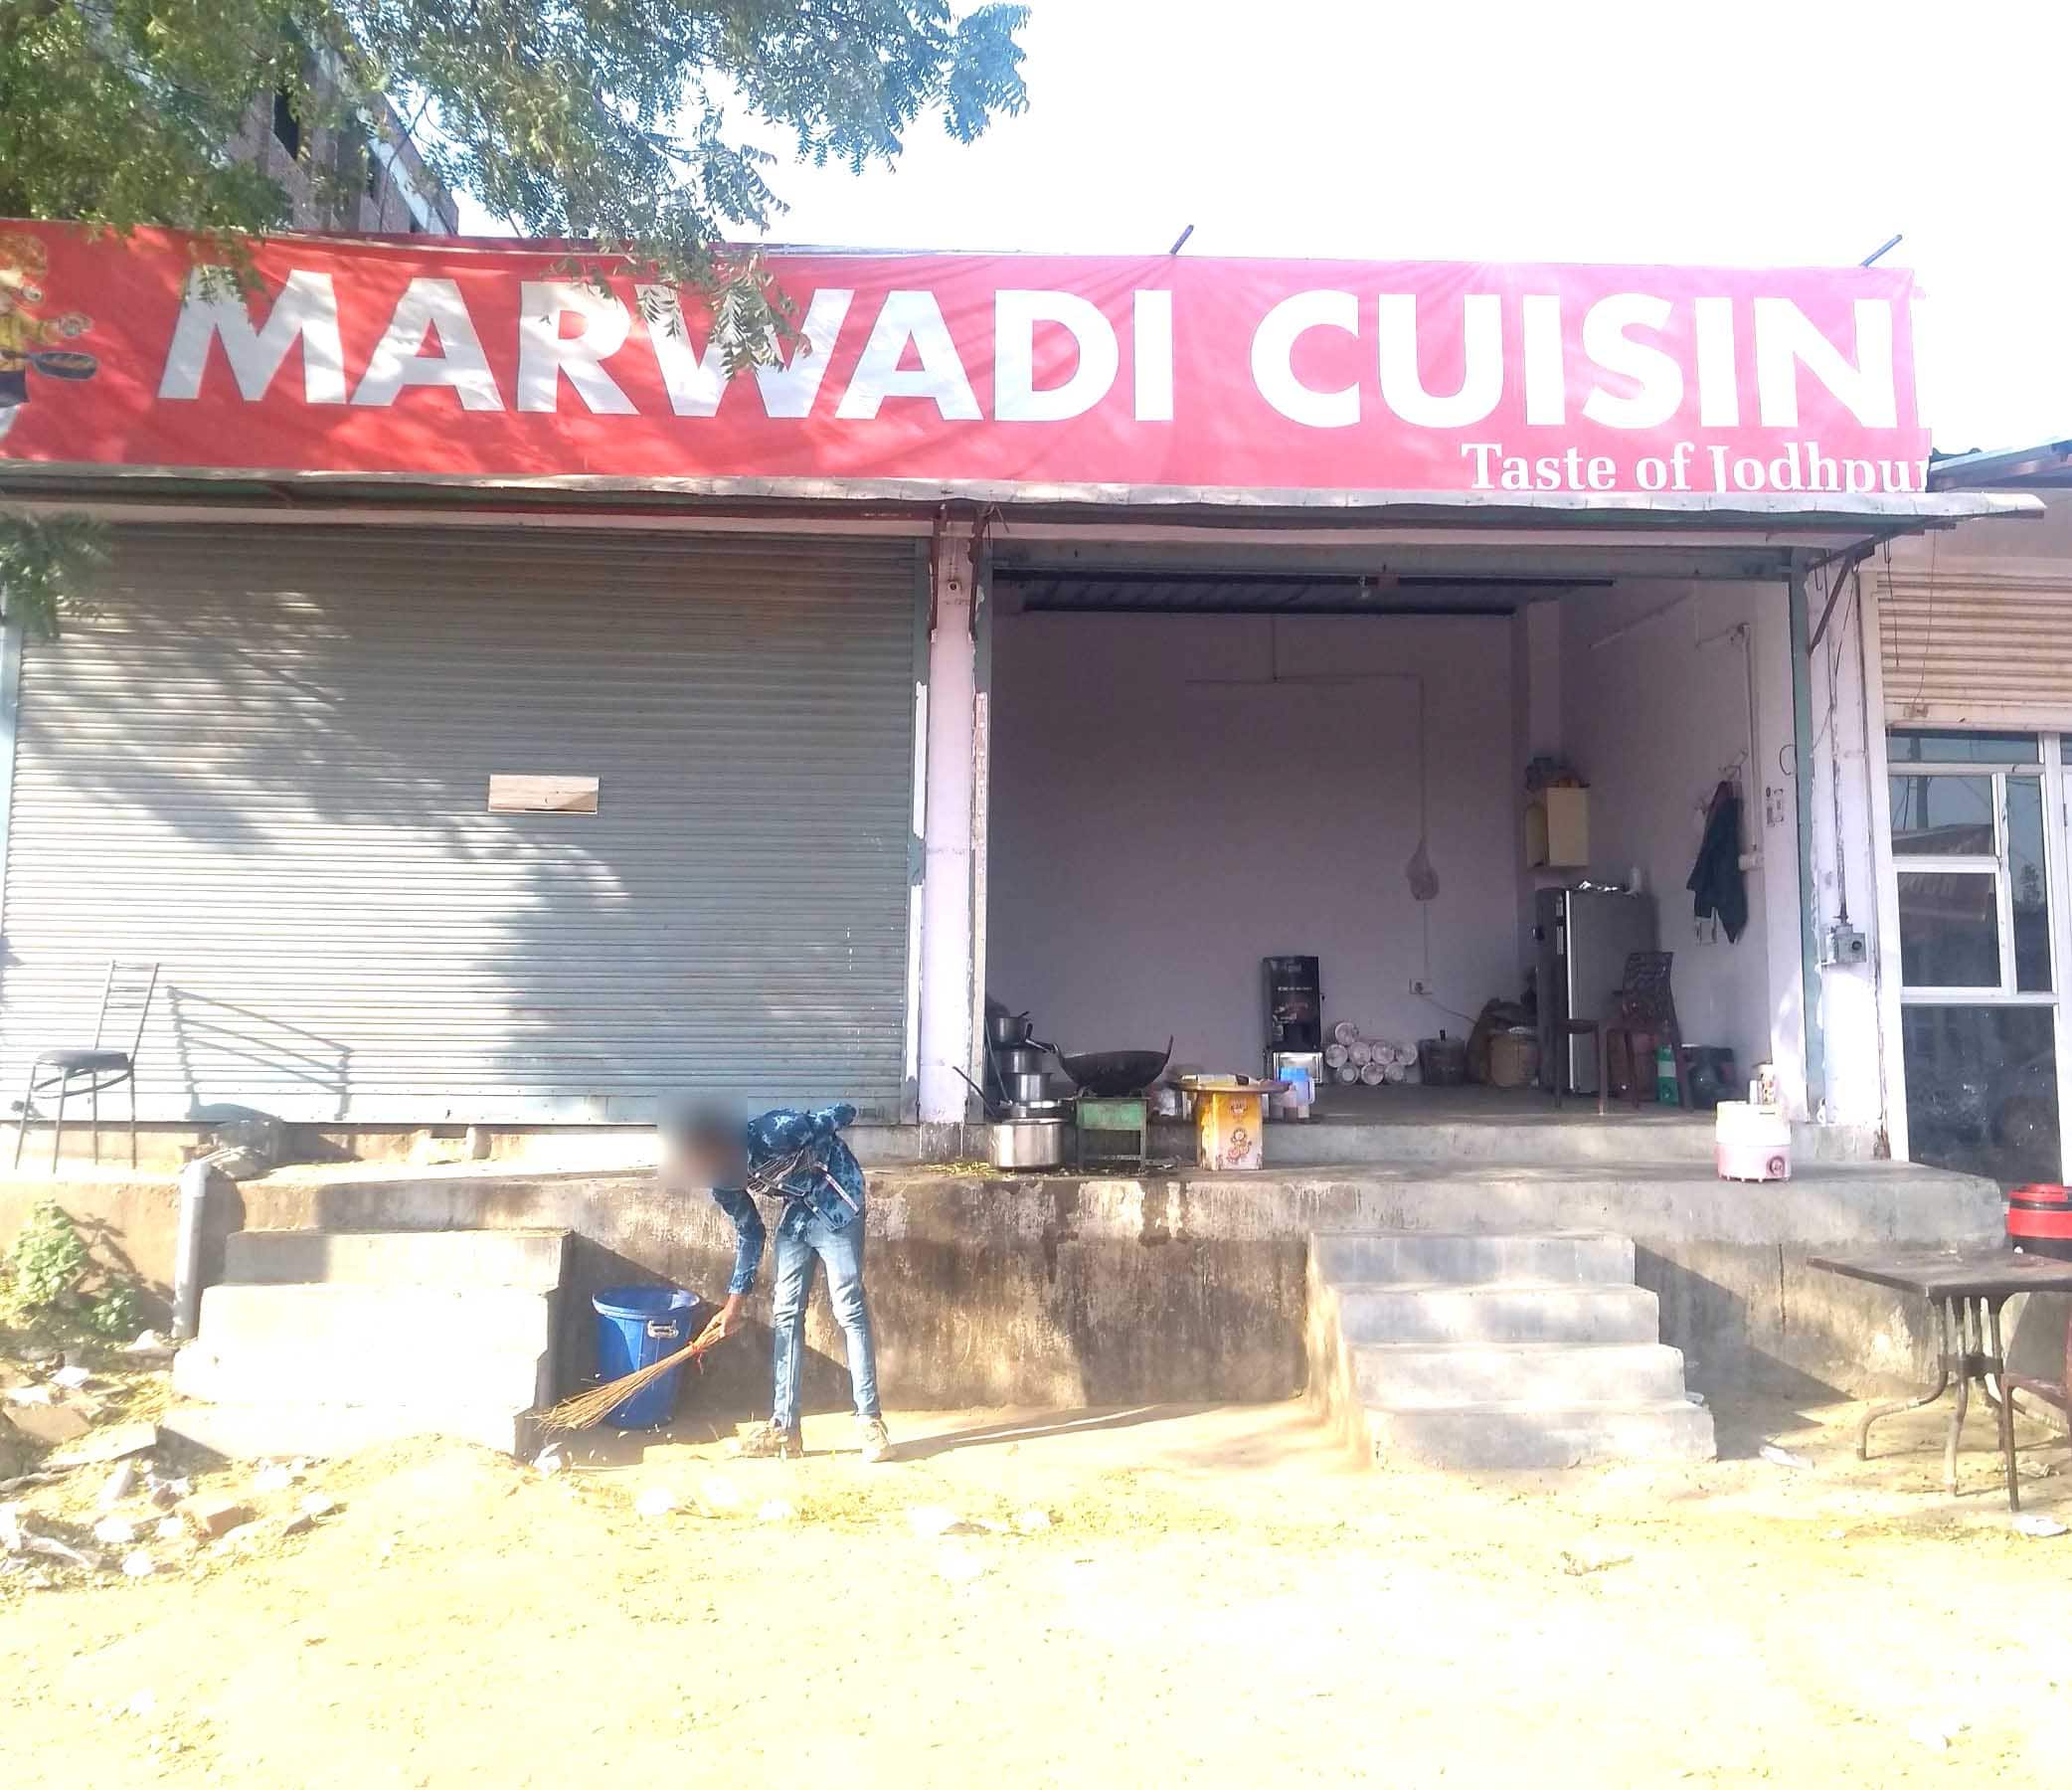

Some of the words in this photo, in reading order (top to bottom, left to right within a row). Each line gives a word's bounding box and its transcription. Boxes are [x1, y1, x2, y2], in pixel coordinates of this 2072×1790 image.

[157, 265, 1173, 423] MARWADI
[1251, 289, 1898, 429] CUISIN
[1461, 443, 1617, 491] Taste
[1636, 442, 1695, 492] of
